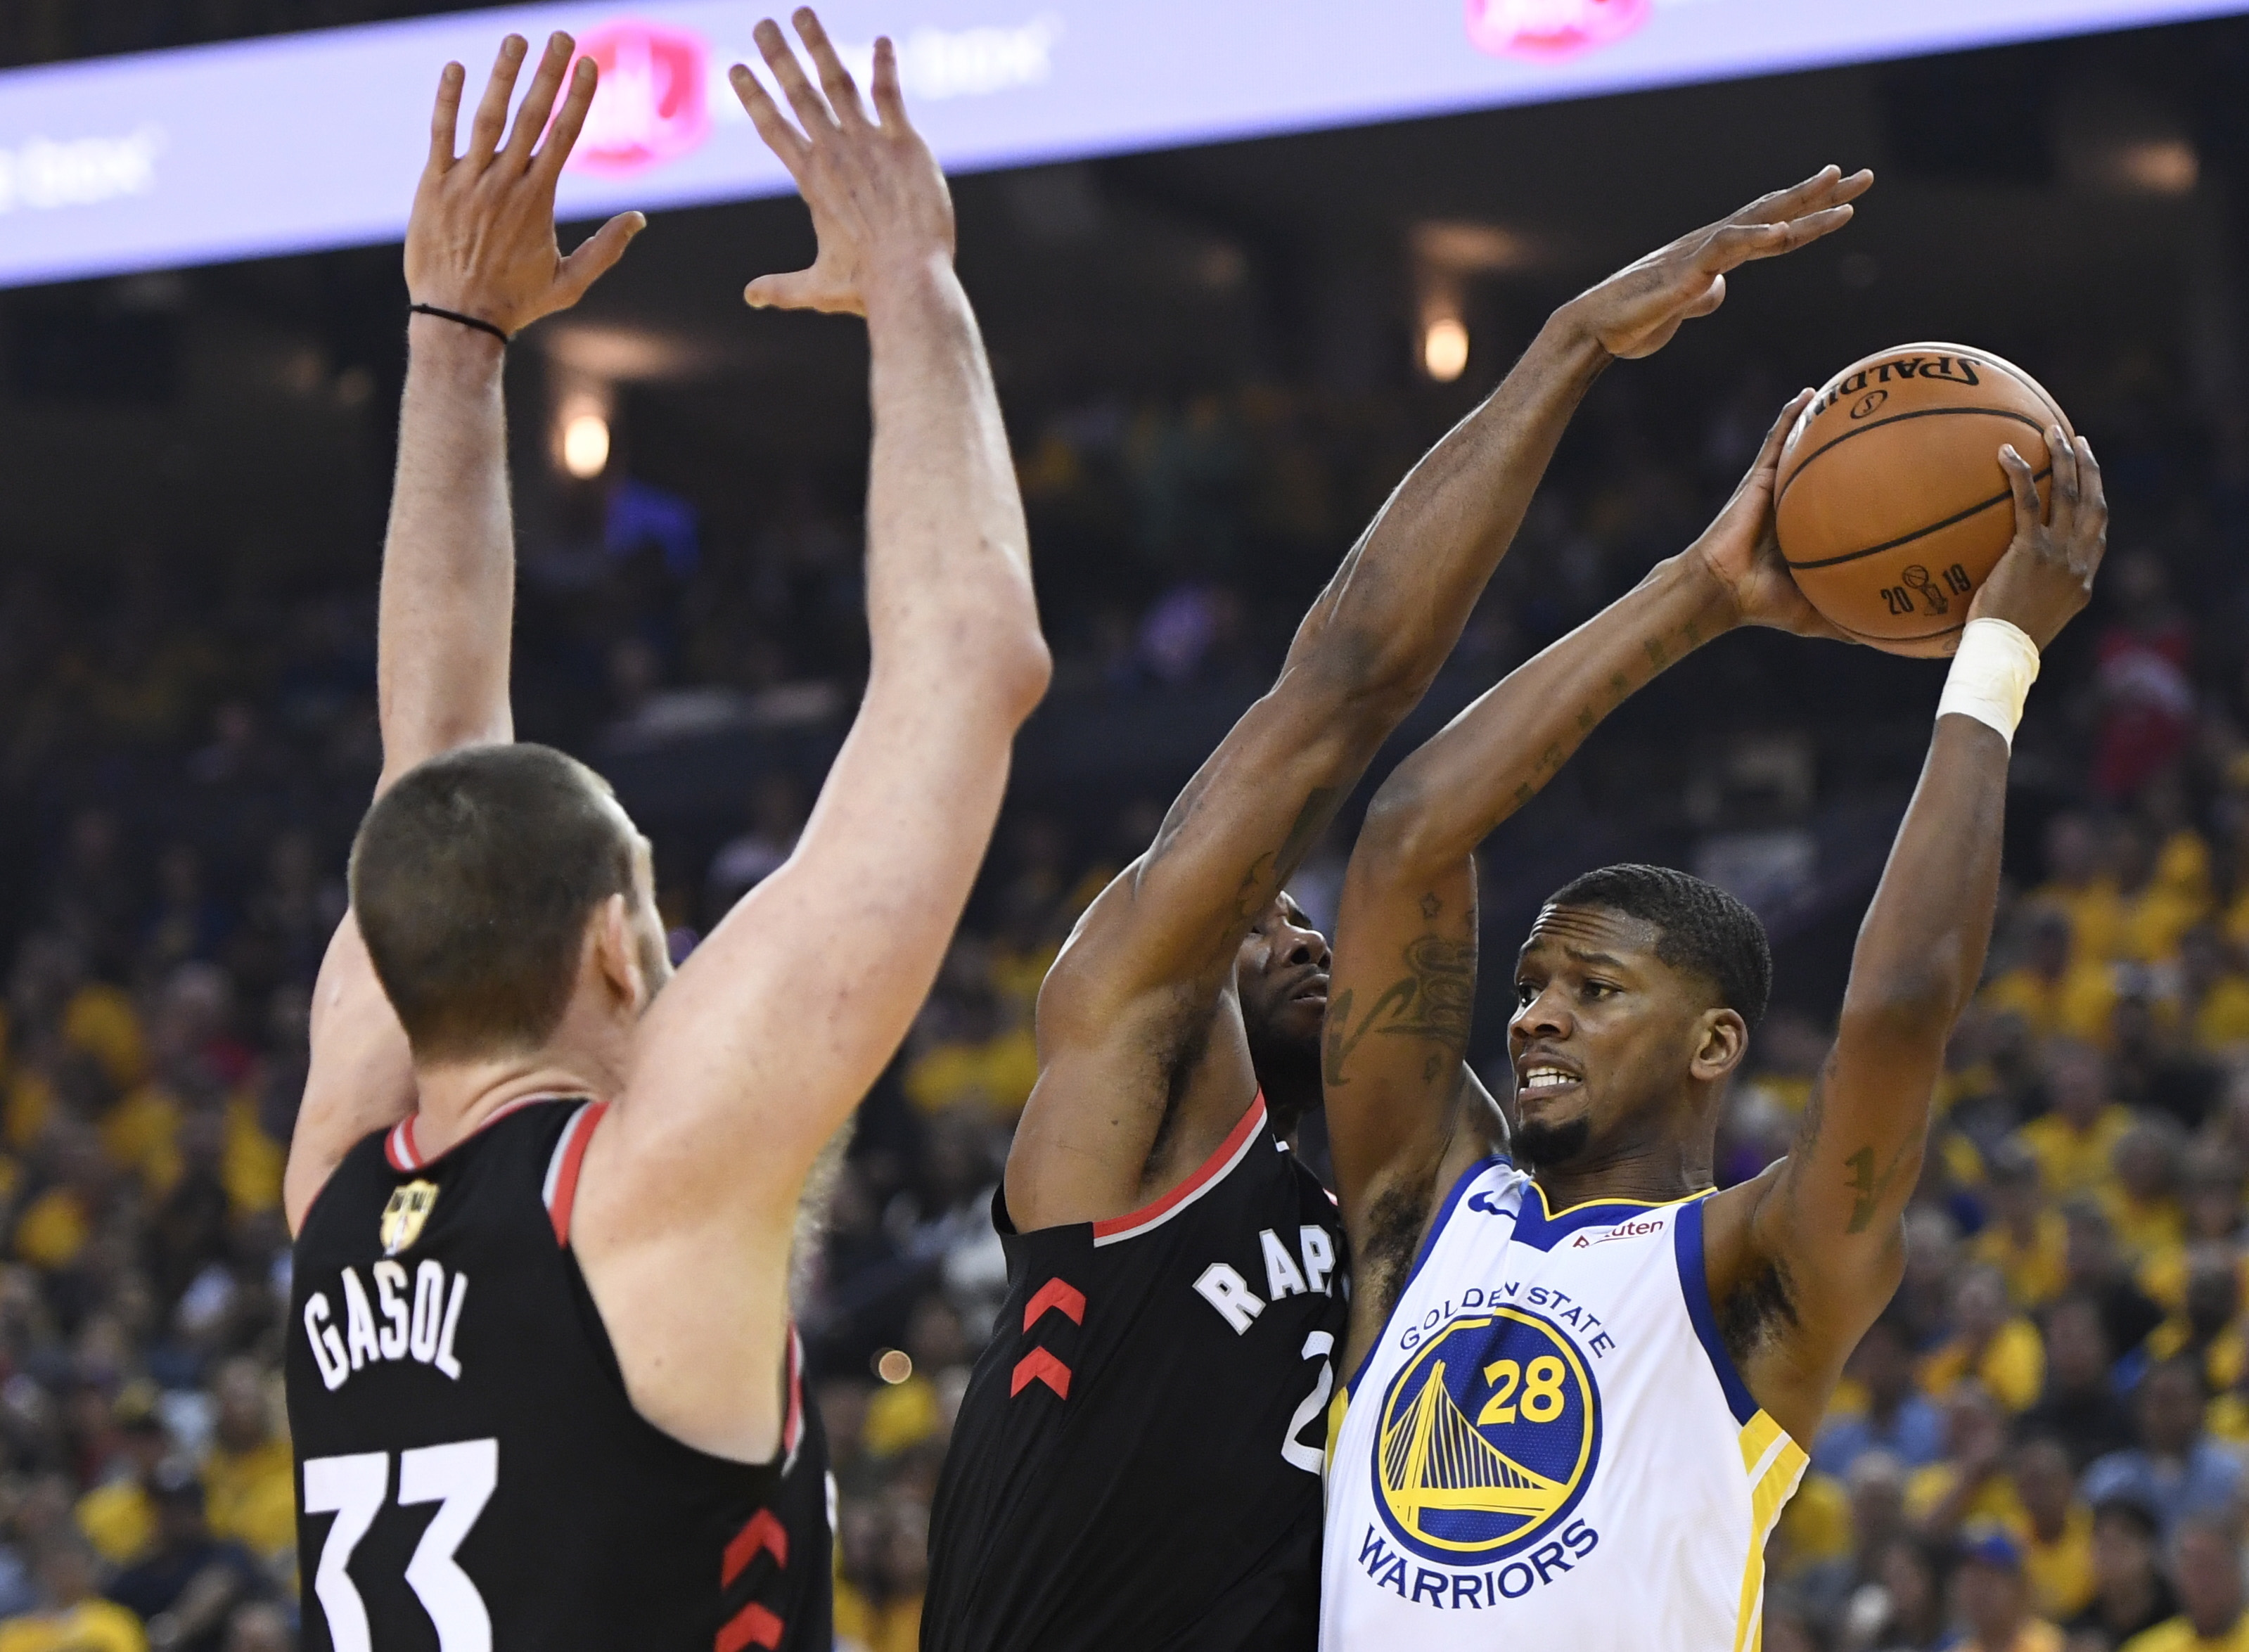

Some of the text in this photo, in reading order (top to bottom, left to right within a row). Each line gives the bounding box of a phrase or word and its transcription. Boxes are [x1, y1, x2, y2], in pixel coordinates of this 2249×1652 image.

[1805, 357, 1981, 428] SPALDI
[1880, 563, 1971, 615] 20 19
[1572, 1221, 1664, 1248] Ruten
[1192, 1224, 1338, 1336] RAP
[304, 1259, 468, 1392] GASOL
[1400, 1281, 1616, 1359] GOLDEN STATE
[1477, 1355, 1566, 1427] 28
[303, 1437, 499, 1652] 33
[1357, 1518, 1599, 1610] WARRIORS
